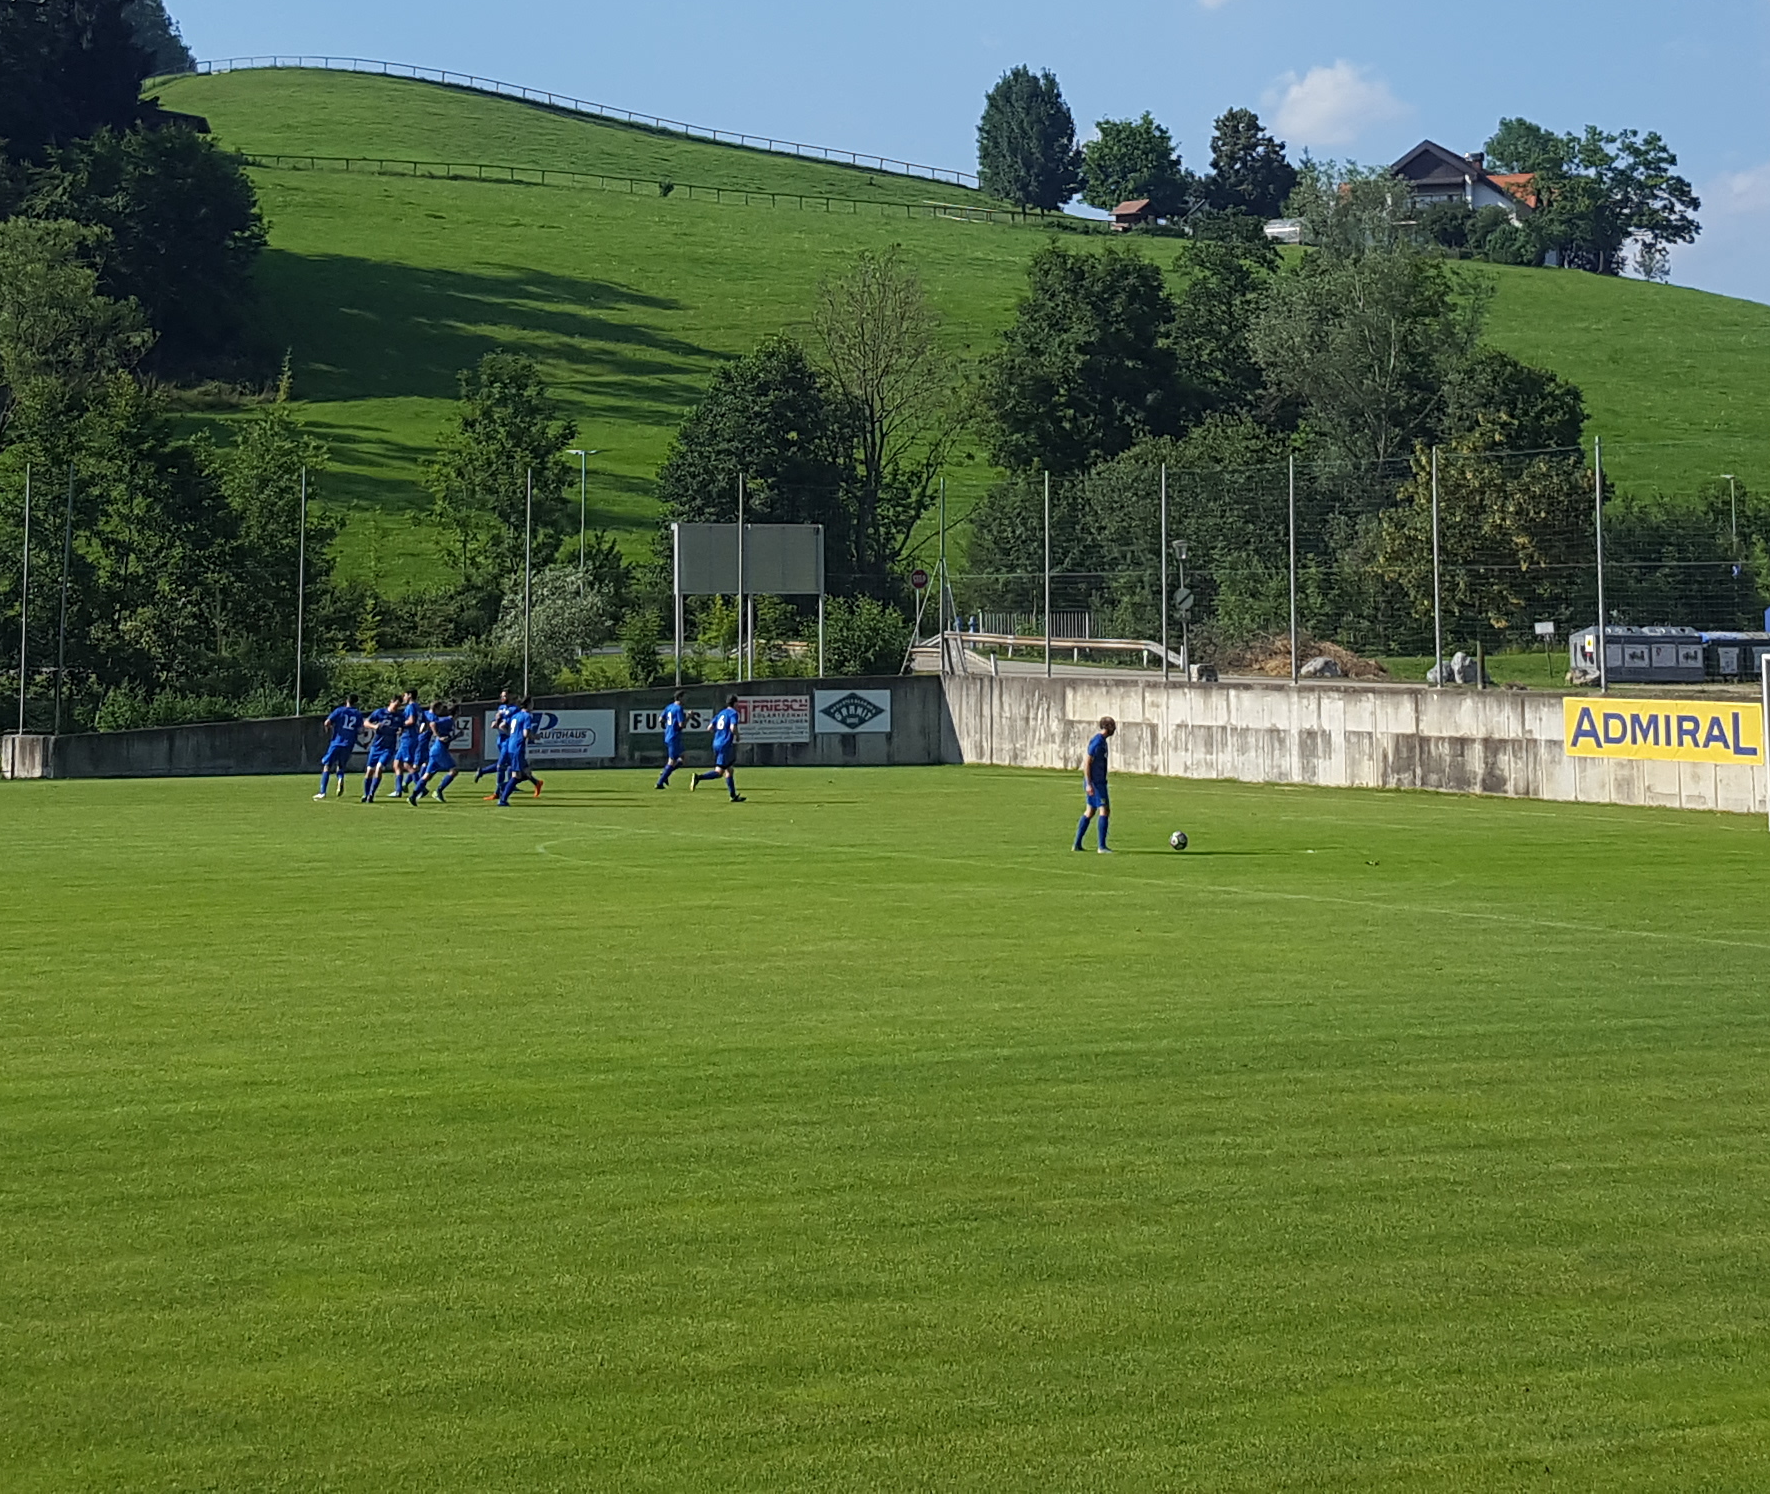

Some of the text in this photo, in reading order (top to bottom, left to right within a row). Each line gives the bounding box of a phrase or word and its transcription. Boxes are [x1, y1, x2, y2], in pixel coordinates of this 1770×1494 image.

[752, 699, 808, 712] PRIESCH
[834, 705, 872, 721] GRANIT
[342, 714, 357, 730] 12
[716, 715, 725, 730] 6
[1570, 707, 1758, 756] ADMIRAL
